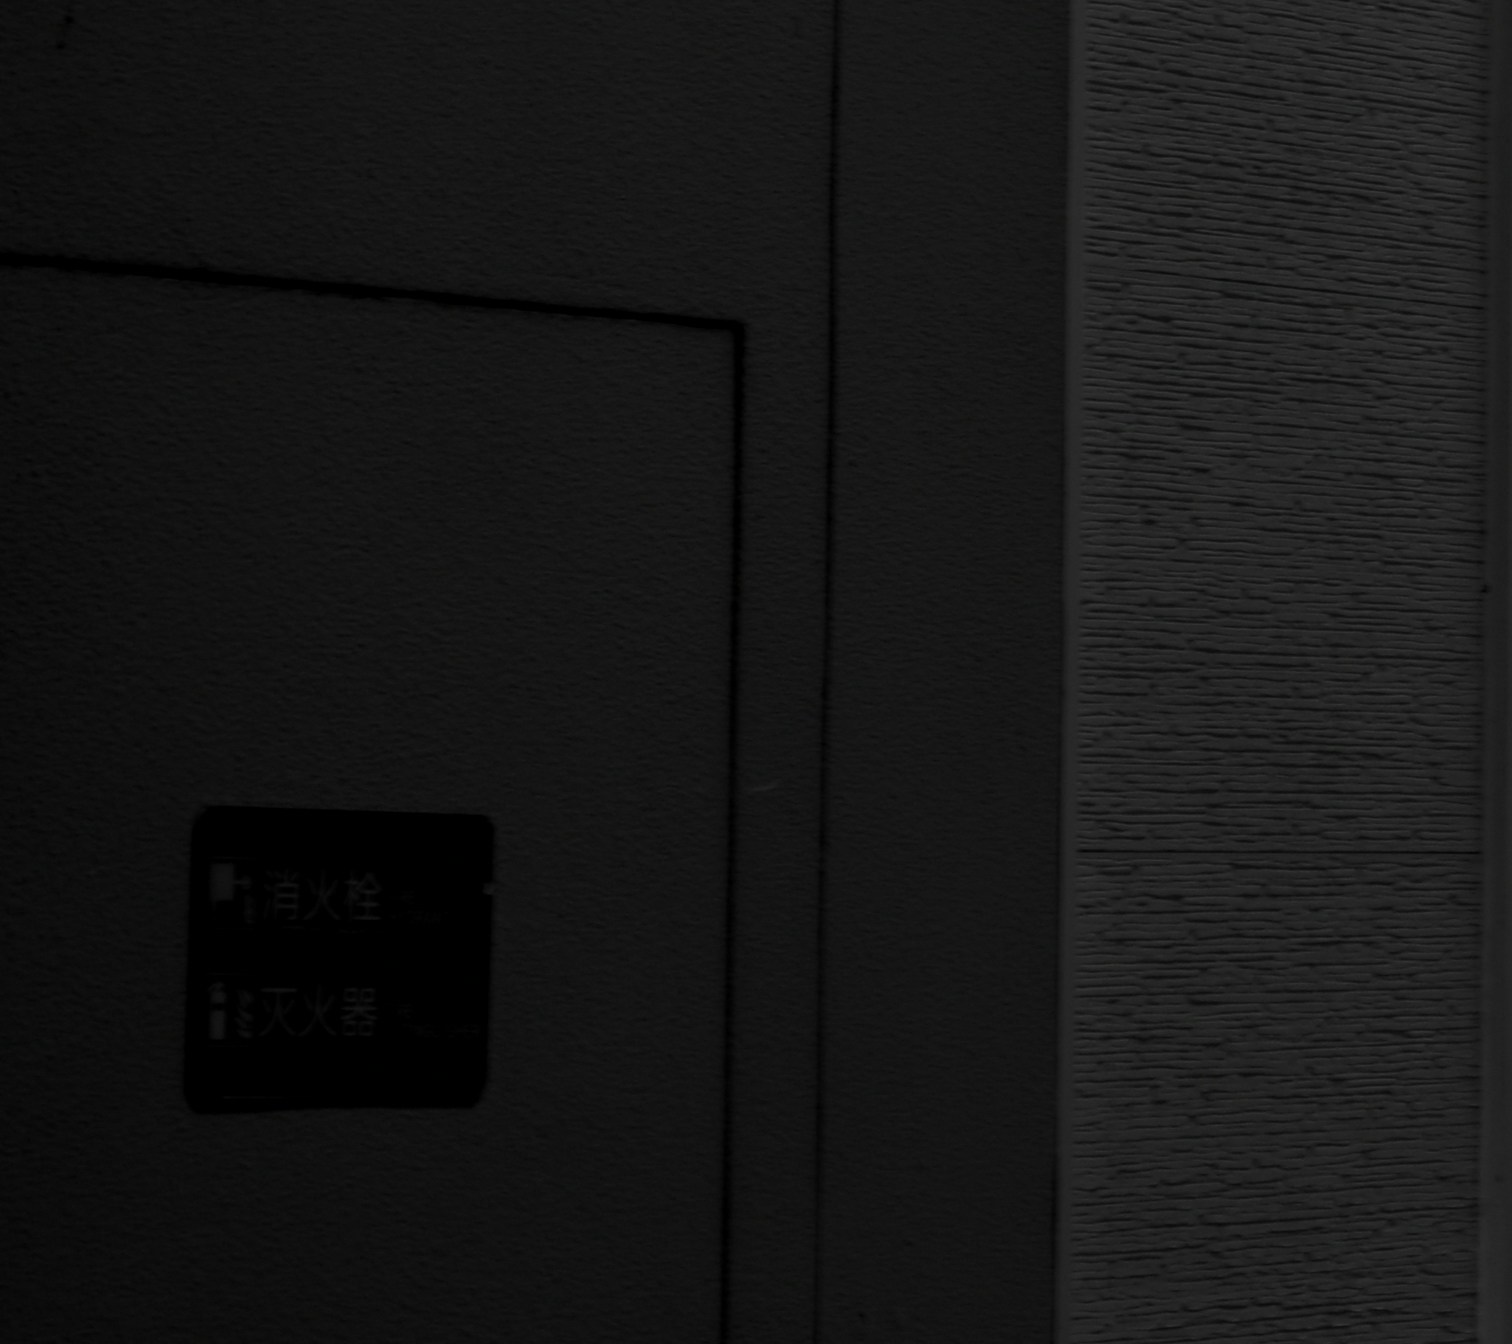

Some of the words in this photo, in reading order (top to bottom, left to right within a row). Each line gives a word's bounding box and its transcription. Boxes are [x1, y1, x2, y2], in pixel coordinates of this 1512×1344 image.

[262, 867, 384, 921] 消火栓
[258, 984, 379, 1039] 灭火器
